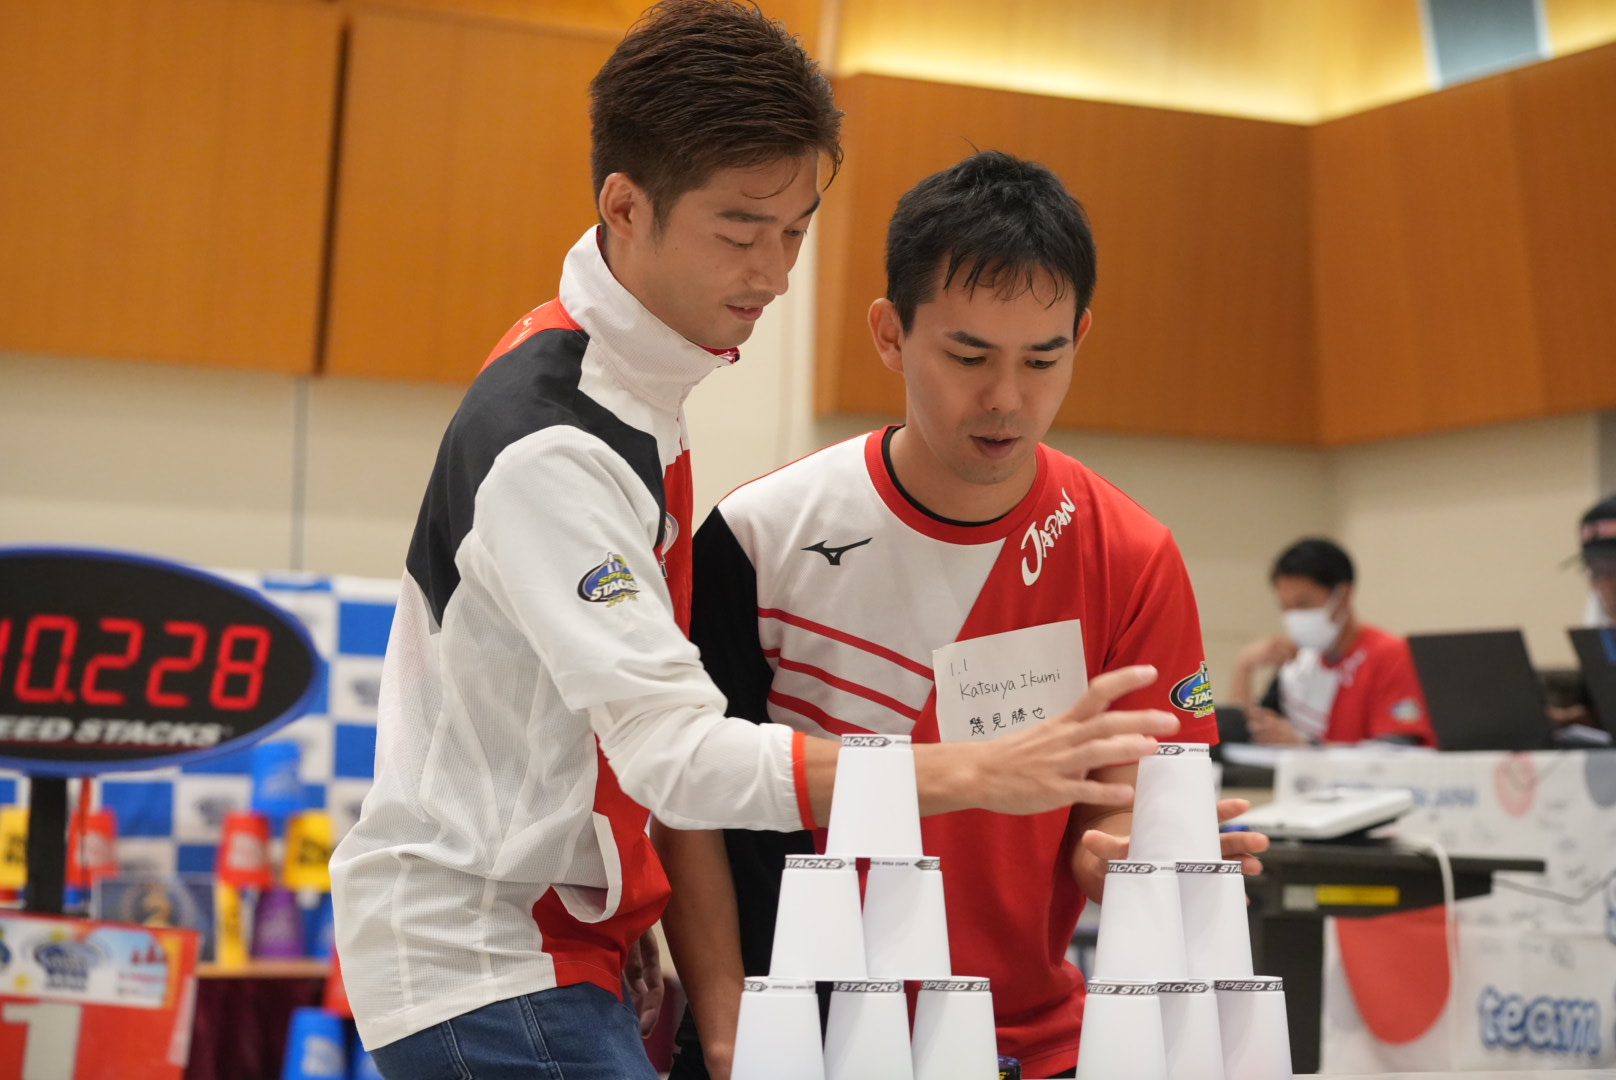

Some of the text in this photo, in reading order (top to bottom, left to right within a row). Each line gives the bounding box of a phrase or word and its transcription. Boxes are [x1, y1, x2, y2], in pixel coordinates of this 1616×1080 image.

[1021, 488, 1075, 586] JAPAN
[950, 658, 968, 677] 1.1
[960, 668, 1060, 701] Katsuya Ikumi
[74, 717, 222, 747] STACKS
[839, 982, 900, 992] STACKS
[922, 981, 968, 991] SPEED
[1218, 982, 1266, 991] SPEED
[1478, 983, 1601, 1057] team
